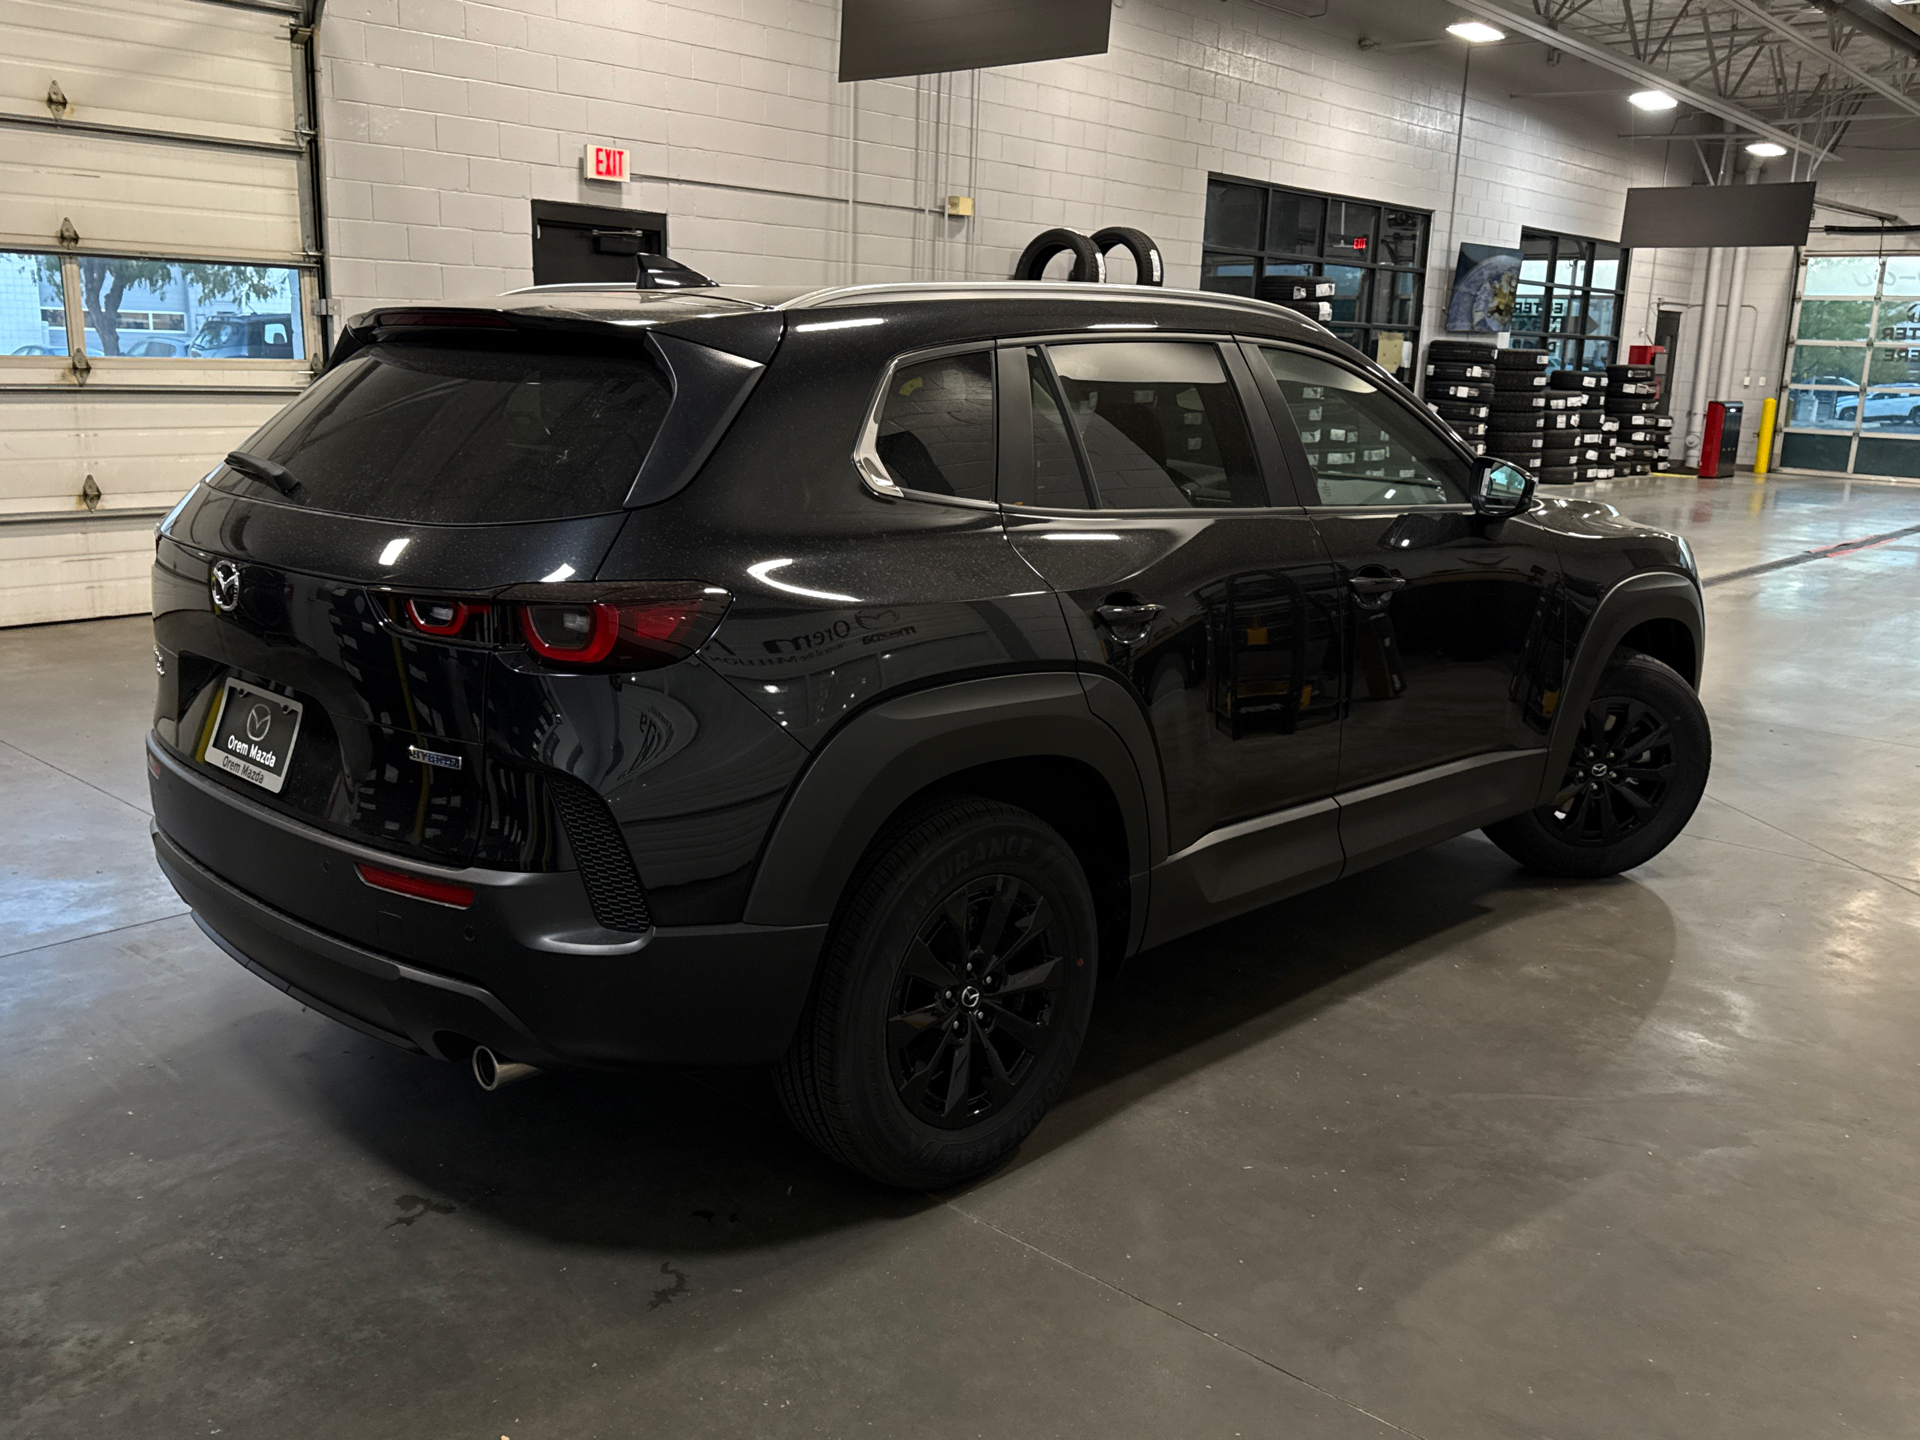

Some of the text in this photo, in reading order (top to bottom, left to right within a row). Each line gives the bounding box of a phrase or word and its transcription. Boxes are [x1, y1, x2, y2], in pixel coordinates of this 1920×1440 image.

[596, 148, 624, 176] EXIT
[227, 734, 277, 768] Orem Mazda
[222, 755, 265, 784] Orem Mazda
